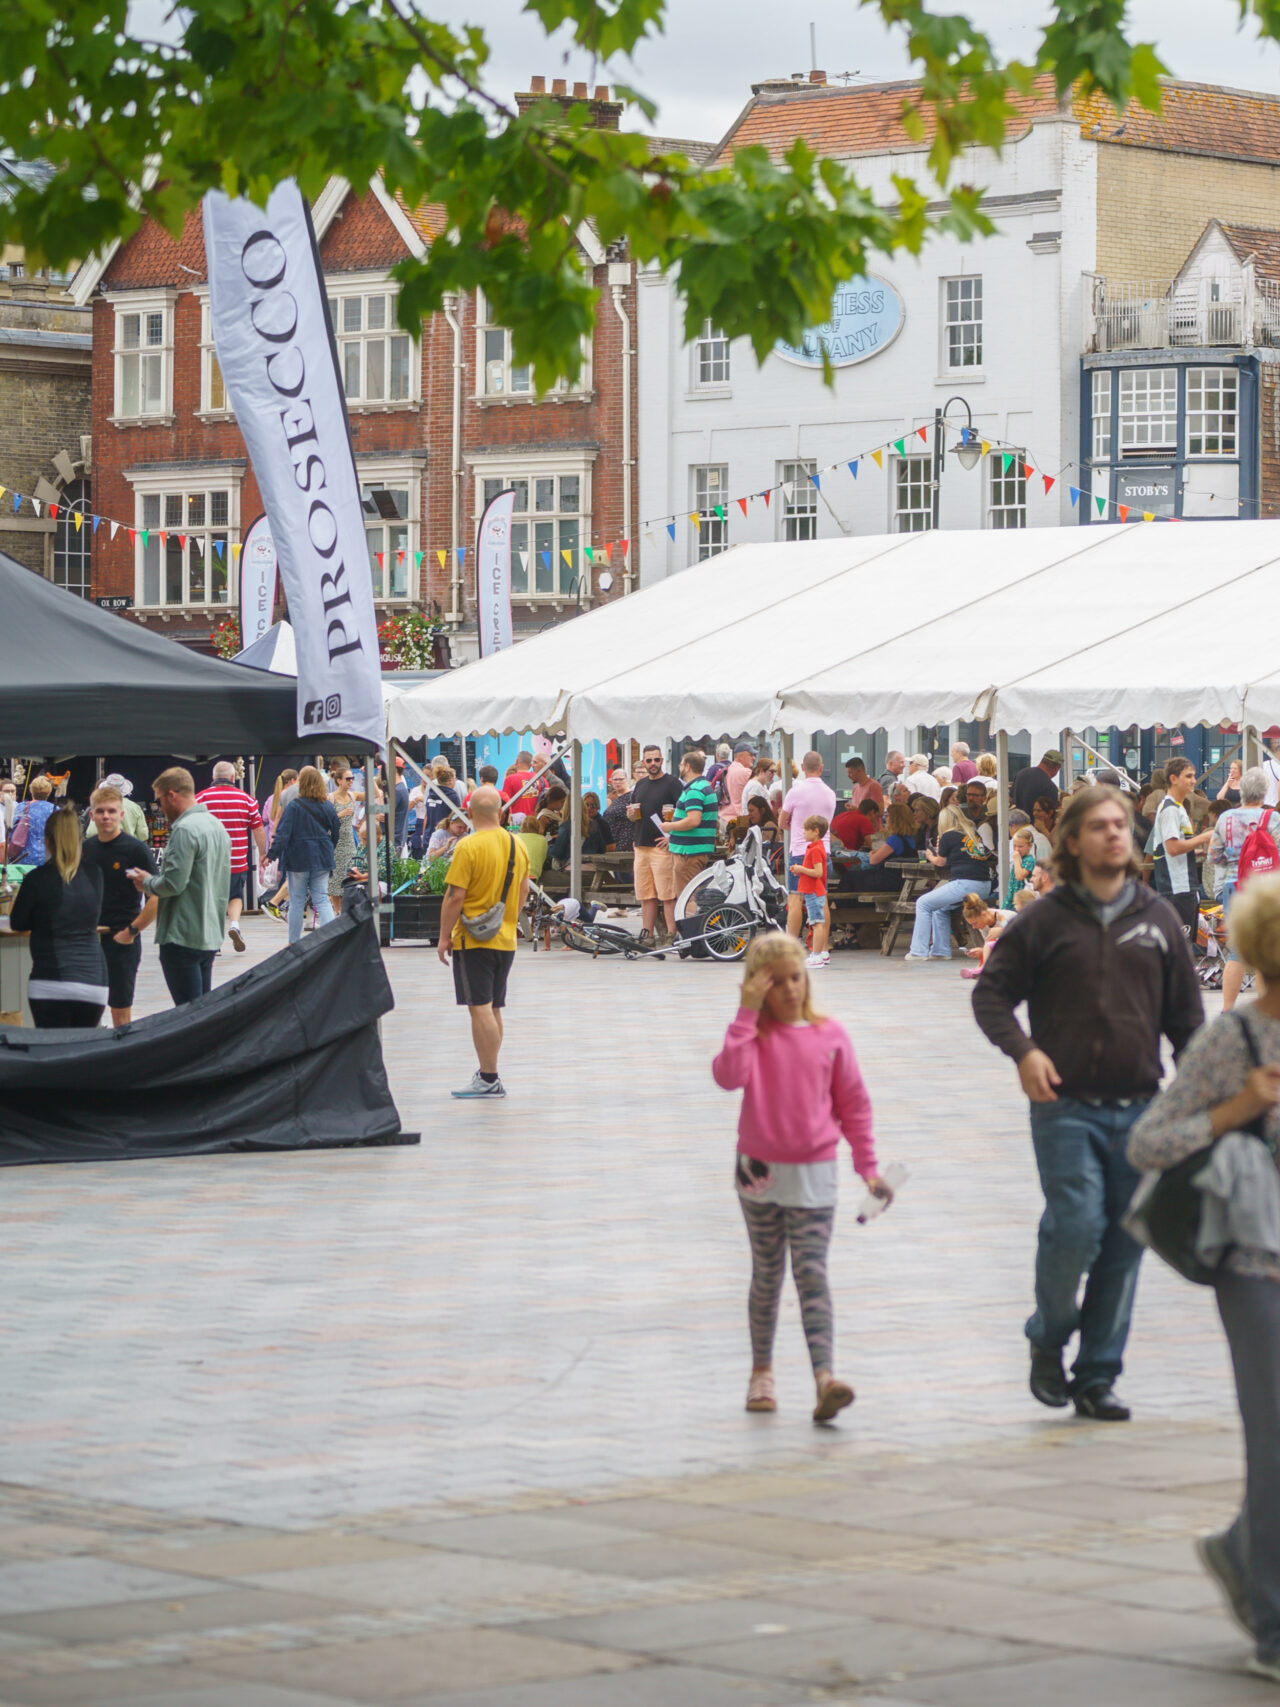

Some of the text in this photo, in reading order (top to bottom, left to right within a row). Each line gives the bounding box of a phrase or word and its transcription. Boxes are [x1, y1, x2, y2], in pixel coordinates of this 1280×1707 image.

[831, 290, 885, 316] HESS
[820, 318, 841, 334] OF
[240, 229, 365, 667] PROSECCO
[1124, 485, 1169, 497] STOBY'S
[492, 552, 501, 596] ICE
[257, 571, 267, 612] ICE
